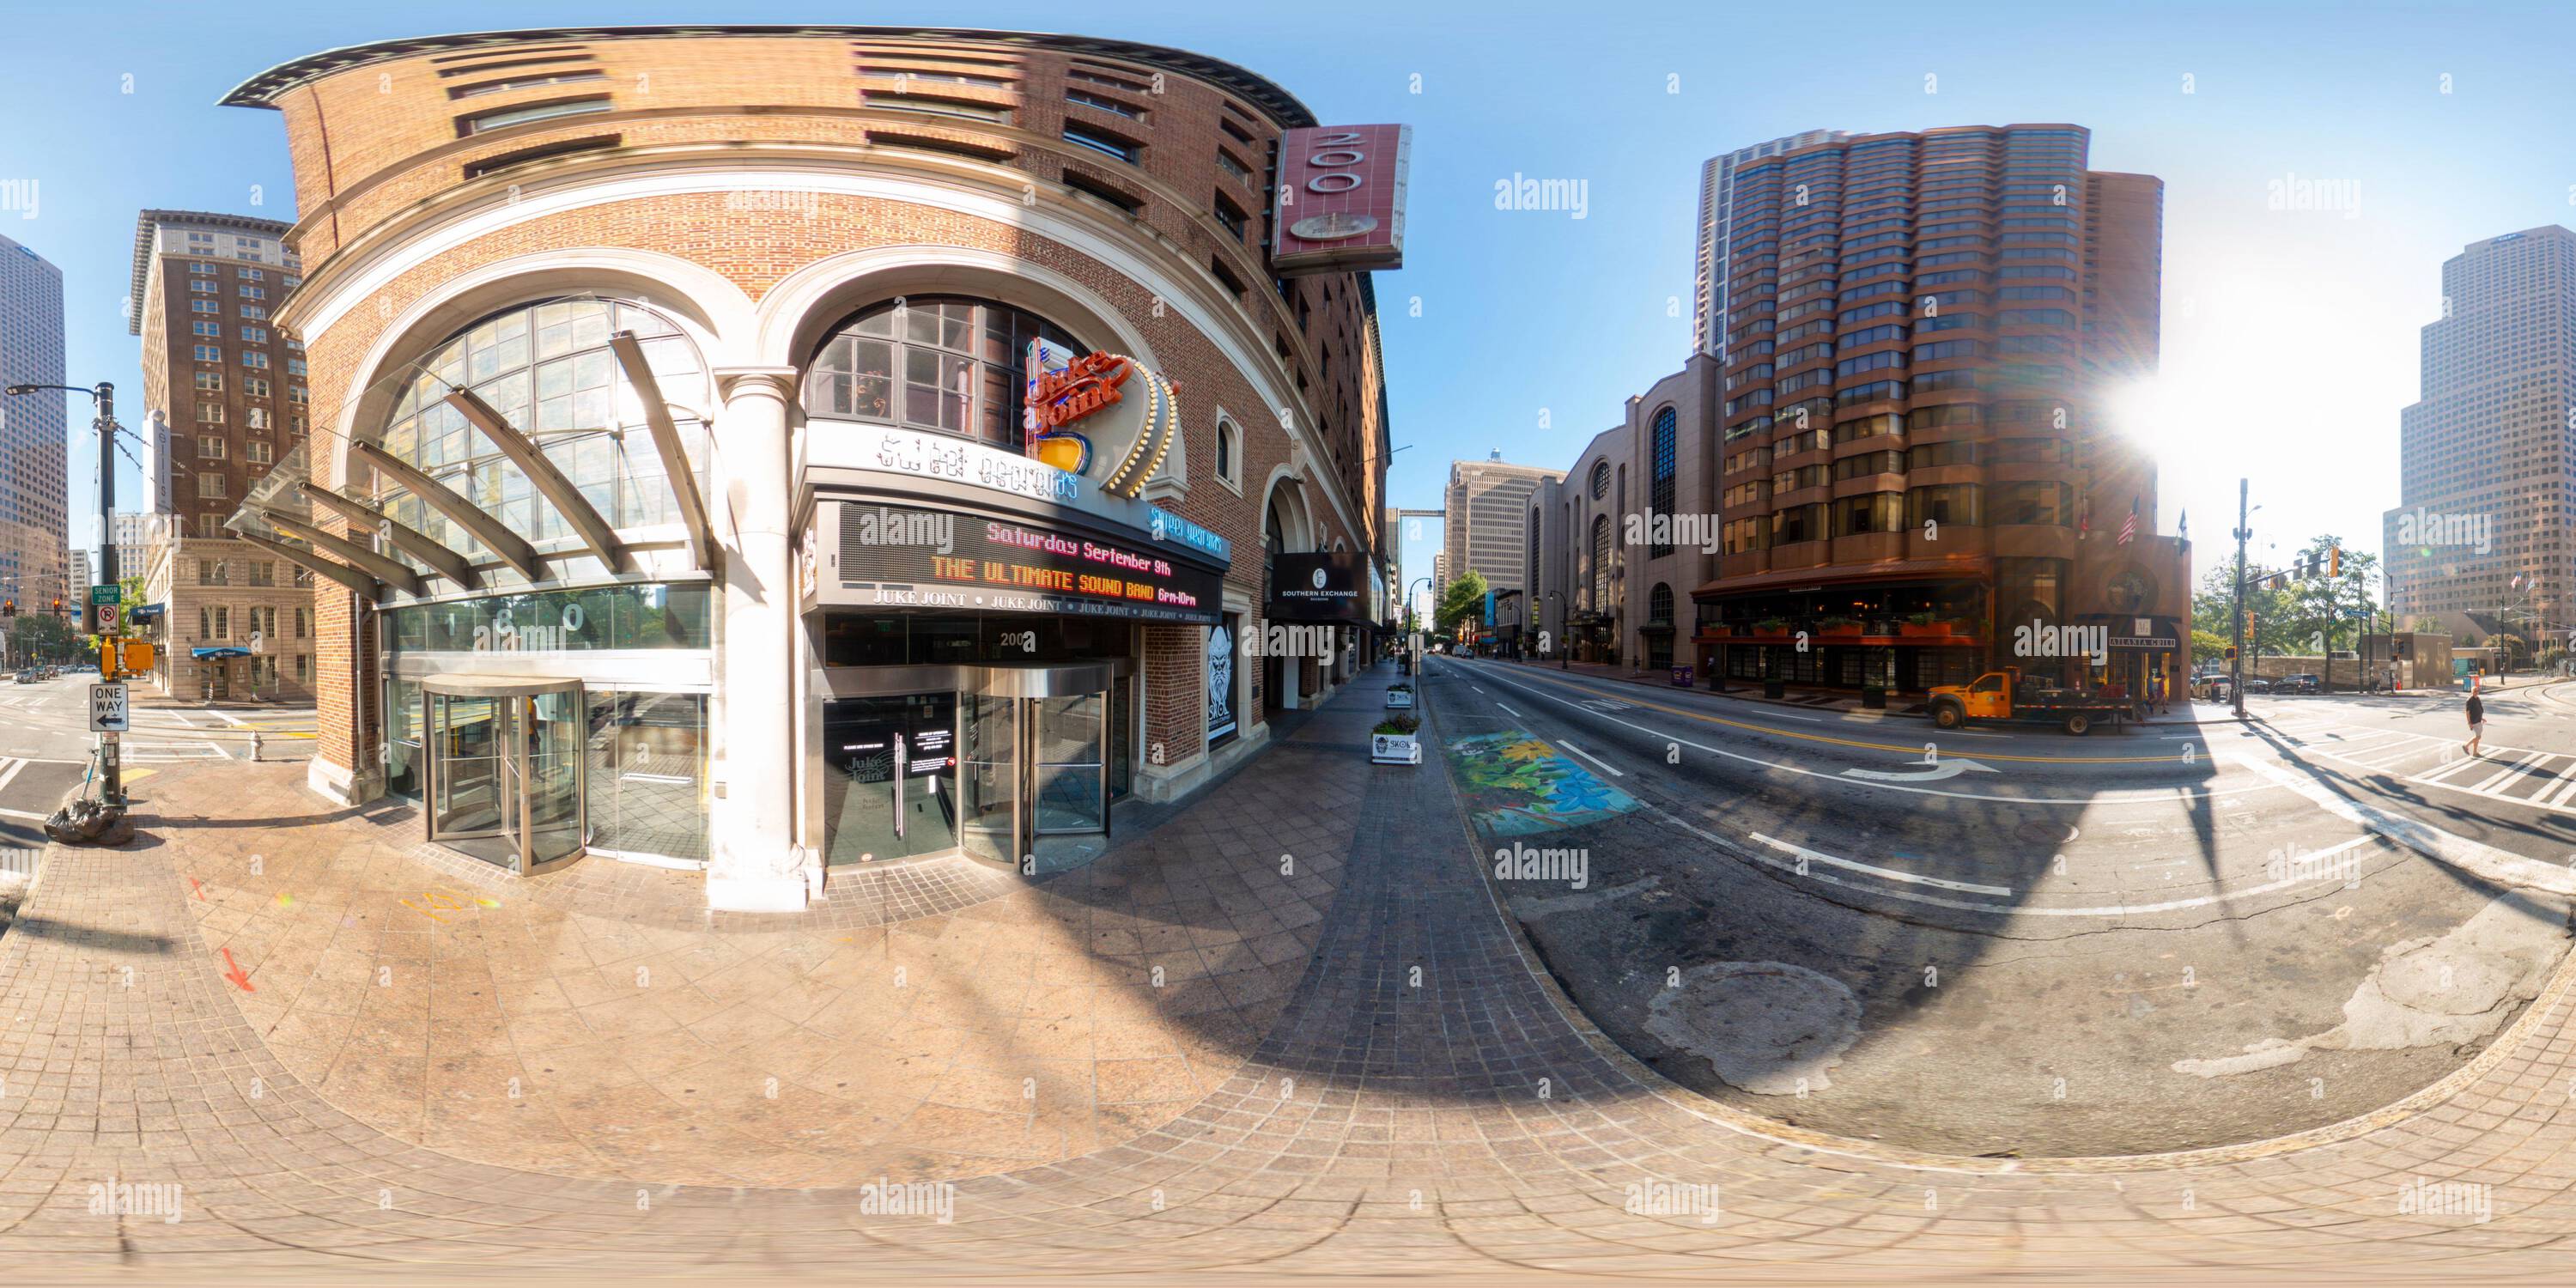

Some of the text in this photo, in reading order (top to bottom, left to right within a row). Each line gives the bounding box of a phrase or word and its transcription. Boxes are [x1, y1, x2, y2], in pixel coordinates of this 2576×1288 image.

[987, 521, 1172, 578] Saturday September 9th
[930, 555, 976, 581] THE
[984, 561, 1074, 591] ULTIMATE
[1078, 574, 1122, 598] SOUND
[1126, 581, 1155, 602] BAND
[872, 590, 967, 607] JUKE JOINT
[991, 596, 1062, 611] JUKE JOINT
[1078, 603, 1129, 617] JUKE JOINT
[1140, 609, 1177, 620] JUKE JOINT
[1000, 632, 1024, 647] 200
[95, 688, 122, 699] ONE
[96, 701, 123, 712] WAY
[1389, 740, 1412, 750] SKOL
